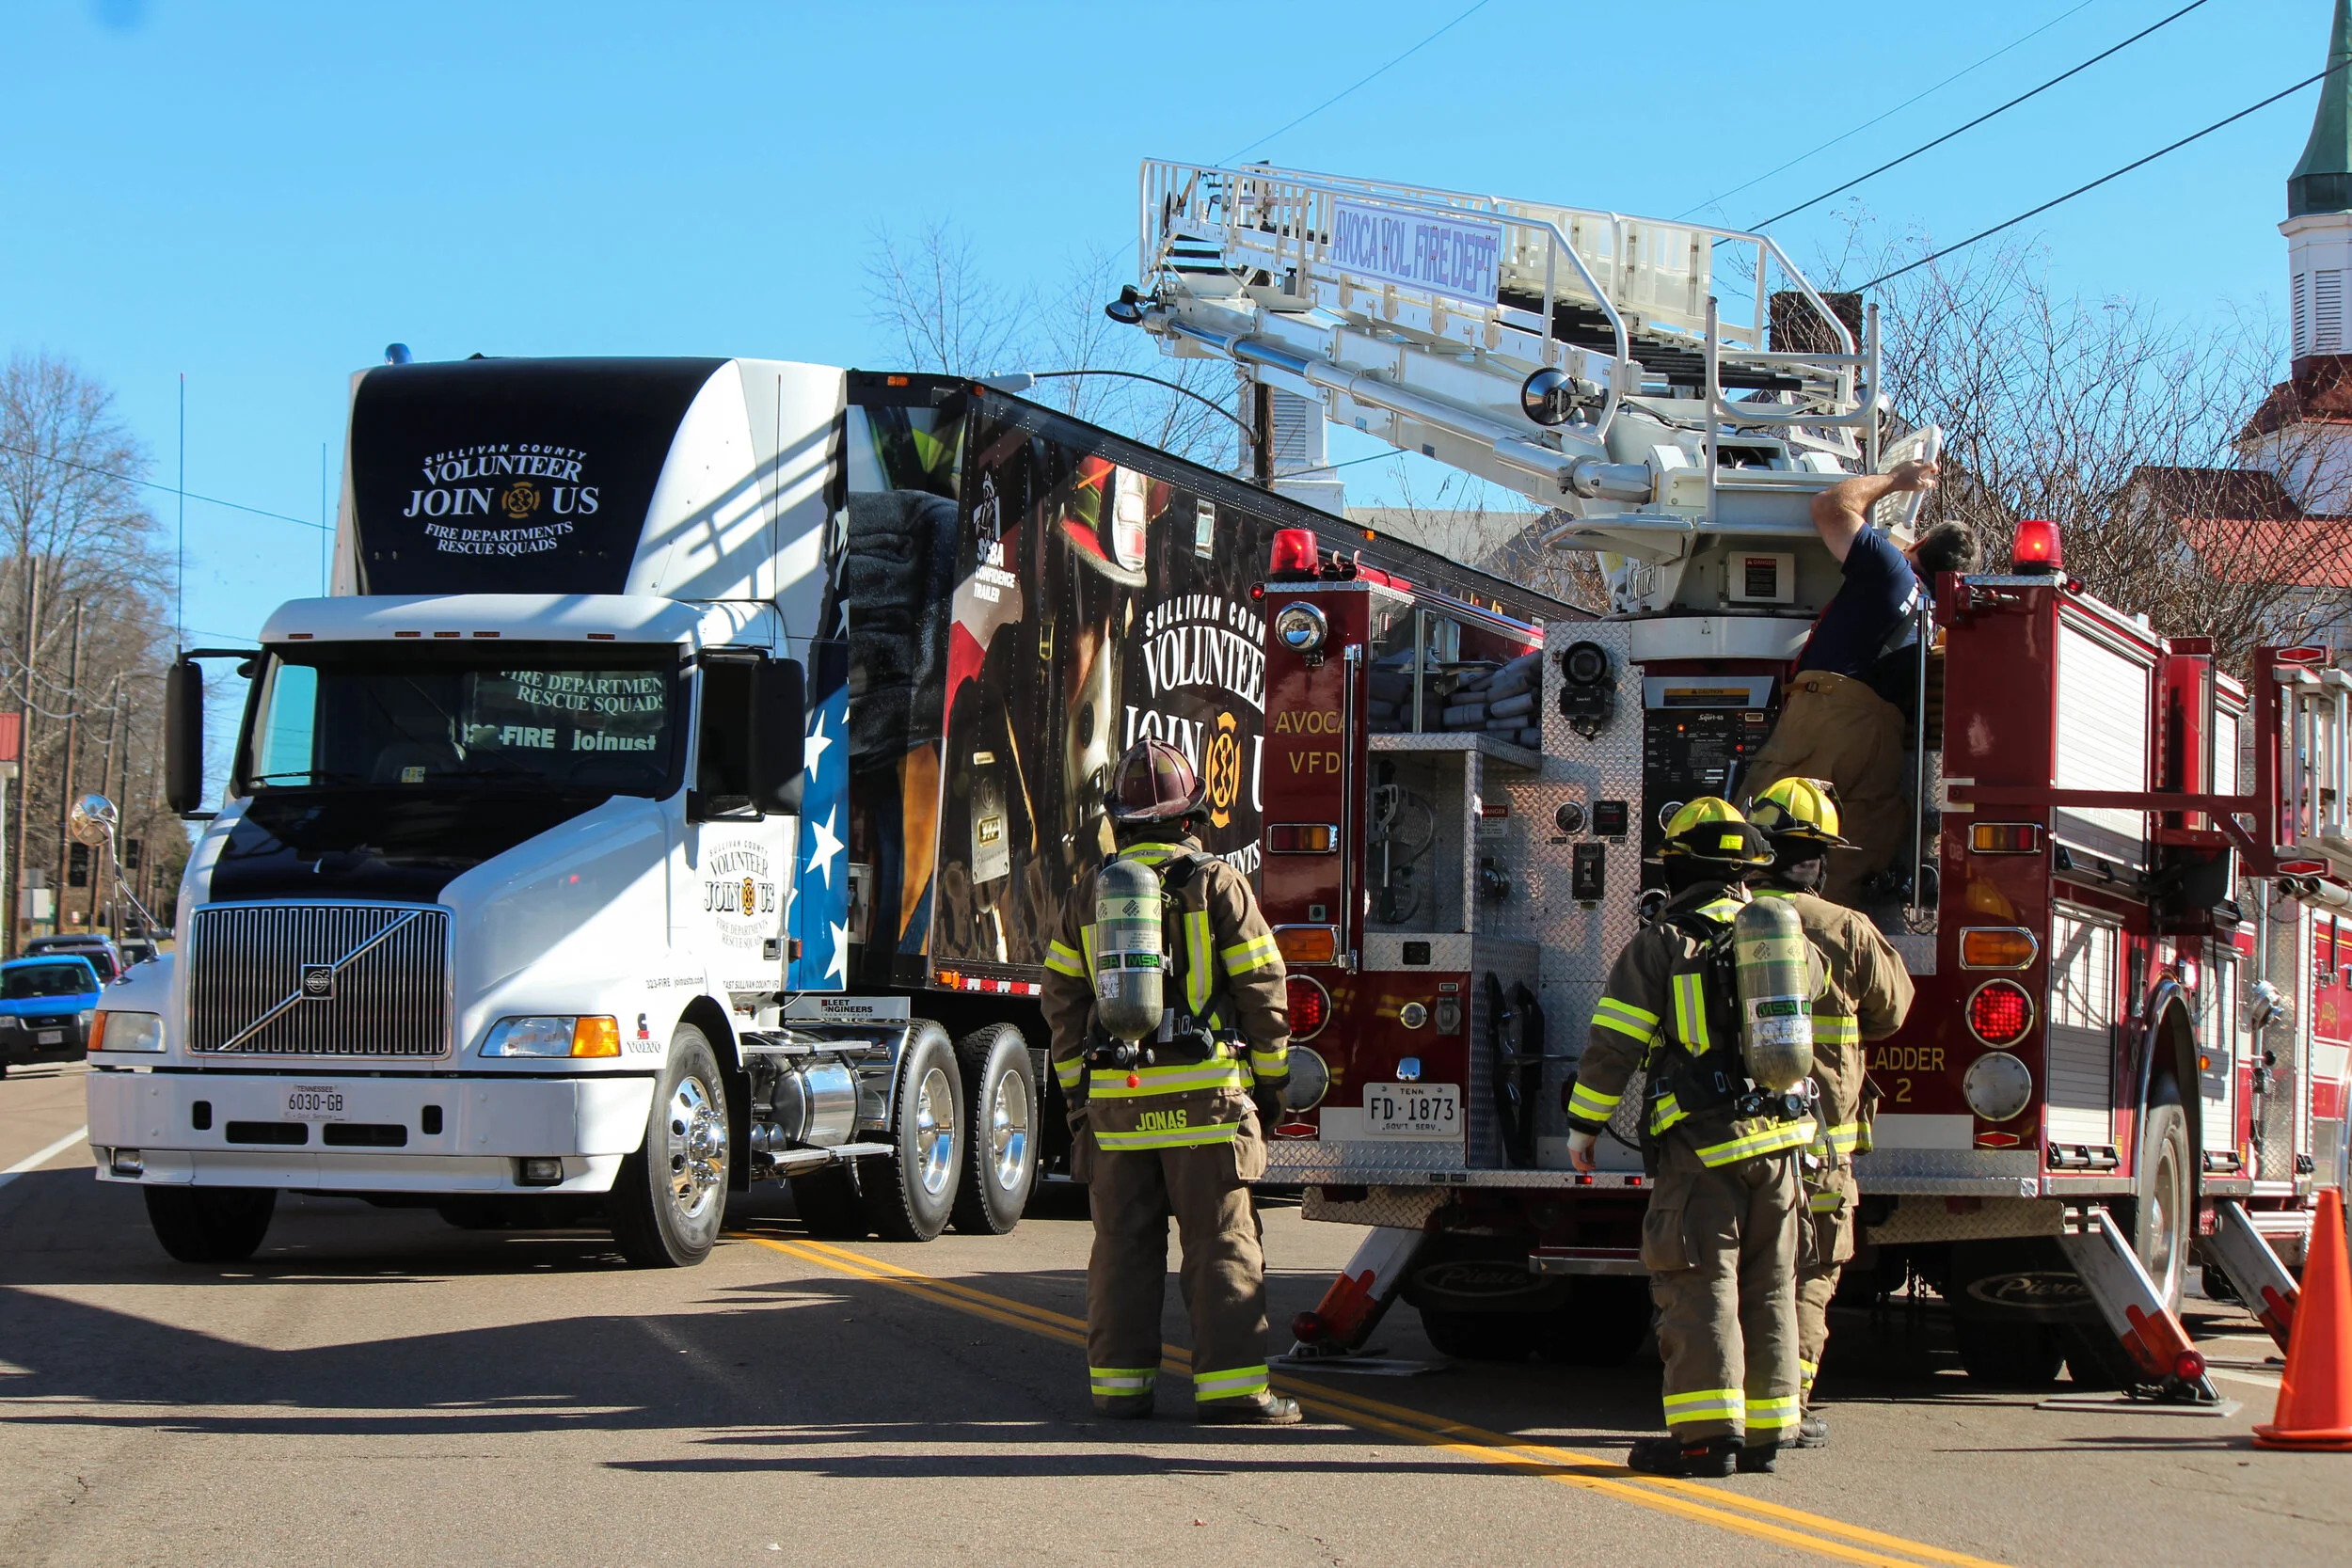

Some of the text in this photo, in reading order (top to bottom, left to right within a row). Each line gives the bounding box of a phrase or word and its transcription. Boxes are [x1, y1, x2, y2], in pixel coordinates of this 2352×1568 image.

[1332, 211, 1378, 270] AVOCA
[1413, 225, 1452, 287] FIRE
[424, 444, 587, 466] SULLIVAN COUNTY
[422, 455, 582, 485] VOLUNTEER
[404, 486, 598, 516] JOIN US
[424, 521, 573, 541] FIRE DEPARTMENTS
[437, 538, 557, 557] RESCUE SQUADS
[977, 537, 1004, 567] SCBA
[975, 564, 1016, 589] CONFIDENCE
[974, 582, 1000, 603] TRAILER
[1146, 594, 1221, 637] SULLIVAN
[516, 686, 589, 711] RESCUE
[1289, 752, 1341, 773] VFD
[709, 840, 768, 856] SULLIVAN COUNTY
[710, 851, 769, 879] VOLUNTEER
[705, 881, 774, 912] JOIN US
[716, 917, 729, 932] FIRE
[1128, 955, 1159, 966] MSA
[735, 980, 755, 989] SULLIVAN
[755, 980, 771, 989] COUNTY
[1758, 1002, 1797, 1016] MSA
[627, 1041, 661, 1053] VOLVO
[1865, 1047, 1945, 1070] LADDER
[1896, 1077, 1912, 1102] 2
[289, 1094, 342, 1111] 6030-GB
[1136, 1109, 1186, 1131] JONAS
